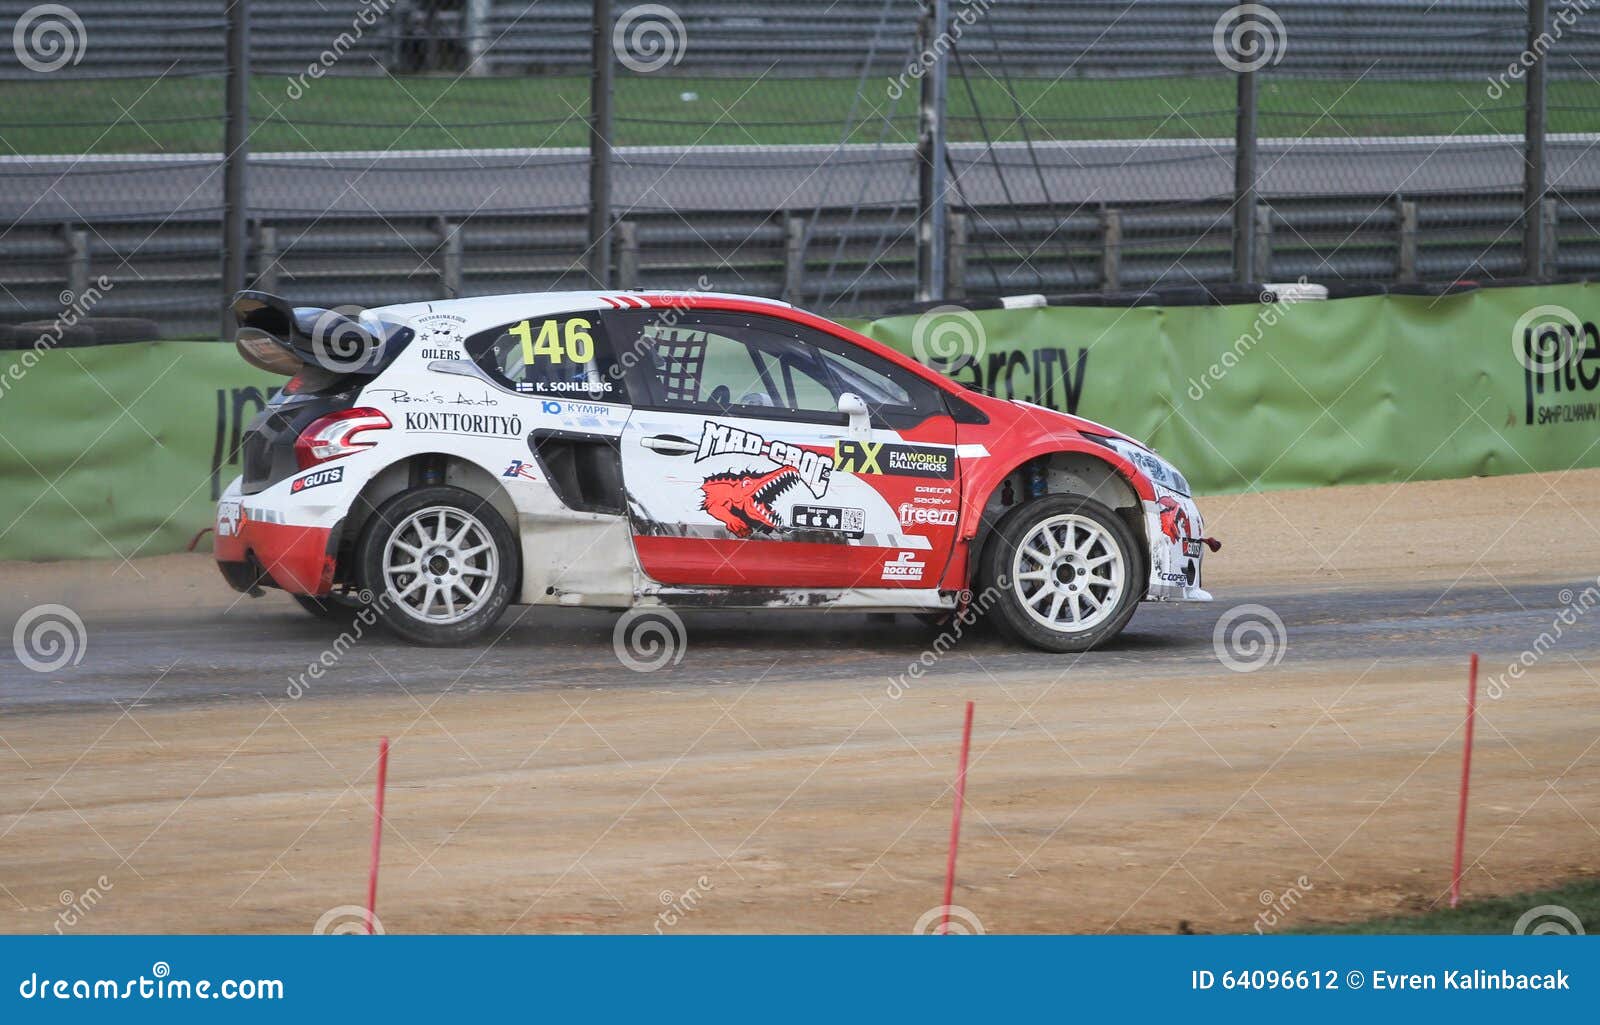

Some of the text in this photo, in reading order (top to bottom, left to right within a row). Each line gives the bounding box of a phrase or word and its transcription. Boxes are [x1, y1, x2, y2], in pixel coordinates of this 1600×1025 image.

[508, 317, 594, 365] 146
[421, 348, 461, 361] OILERS
[536, 382, 613, 393] K. SOHLBERG
[567, 403, 610, 416] KYMPPI
[405, 412, 522, 436] KONTTORITYÖ
[889, 460, 948, 473] RALLYCROSS
[303, 469, 341, 488] GUTS
[884, 566, 923, 575] ROCK OIL
